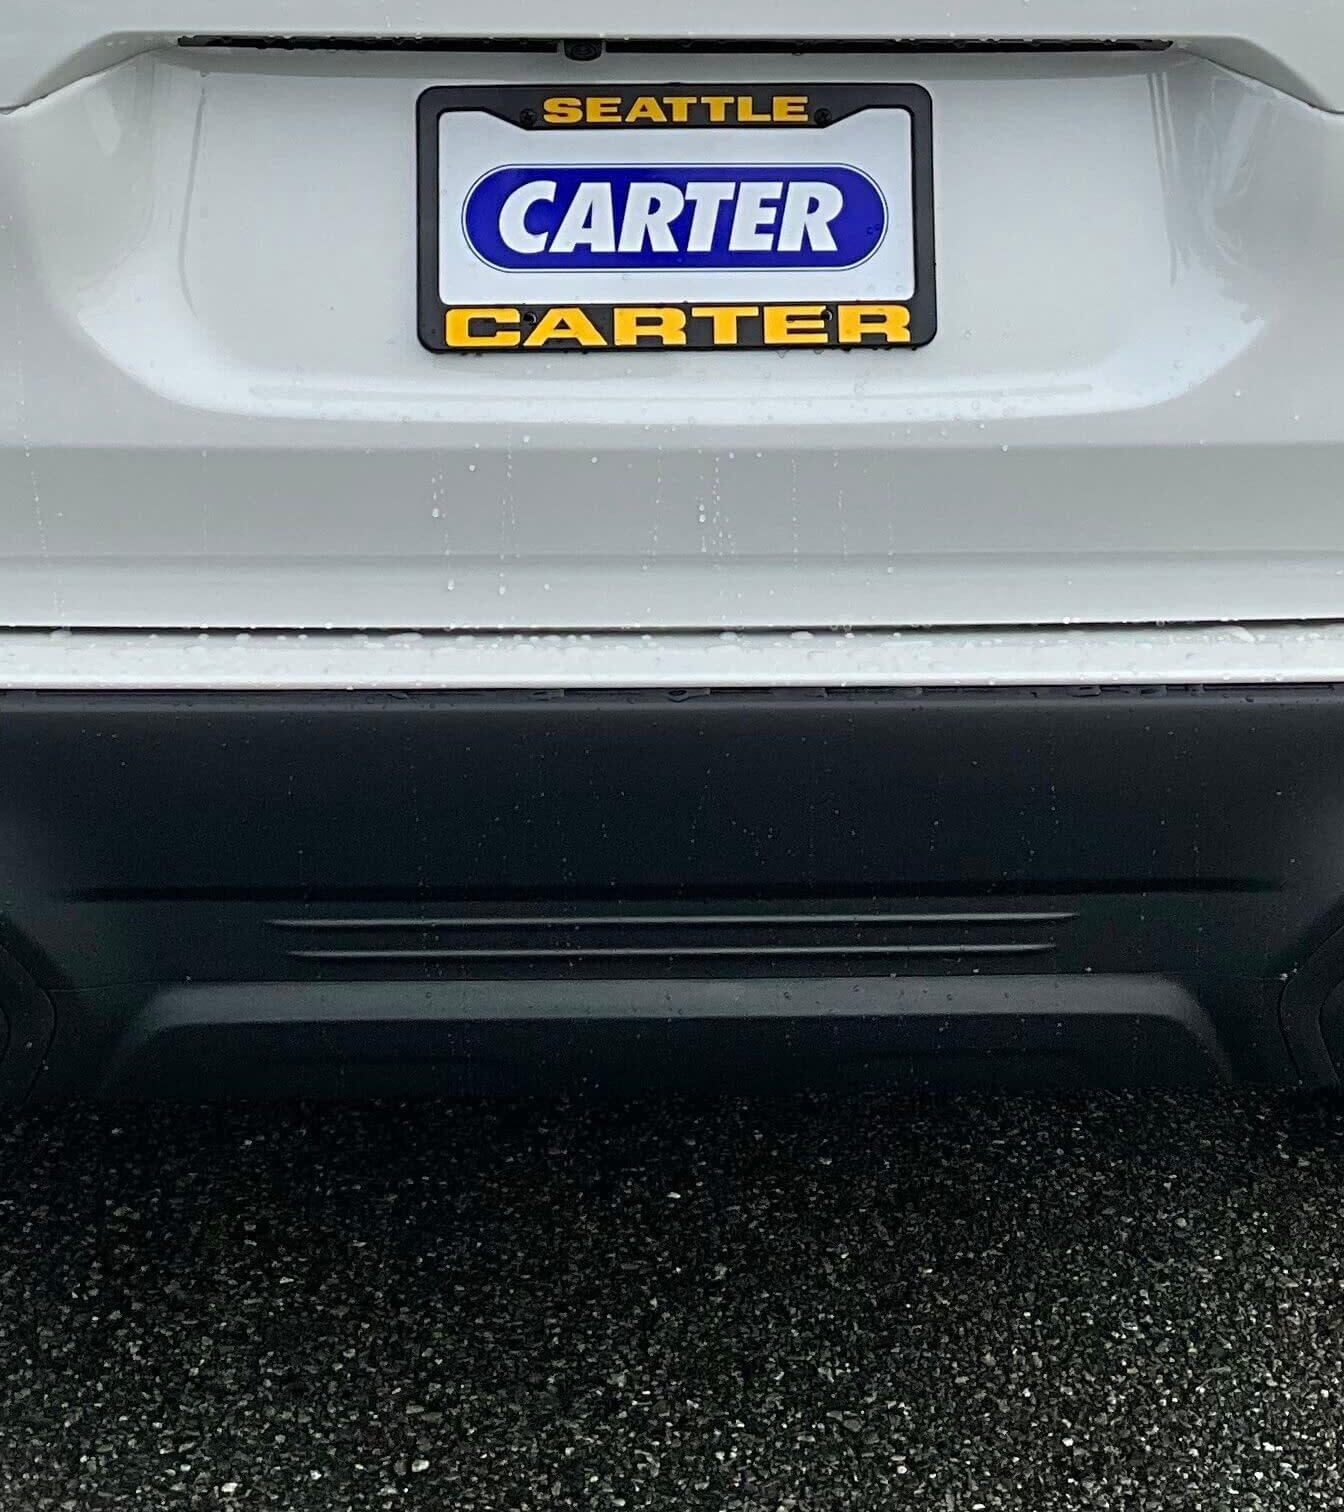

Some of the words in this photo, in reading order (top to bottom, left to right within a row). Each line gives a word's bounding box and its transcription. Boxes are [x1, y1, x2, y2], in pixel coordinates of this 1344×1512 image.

[542, 95, 810, 125] SEATTLE
[497, 178, 844, 255] CARTER
[444, 304, 912, 348] CARTER
